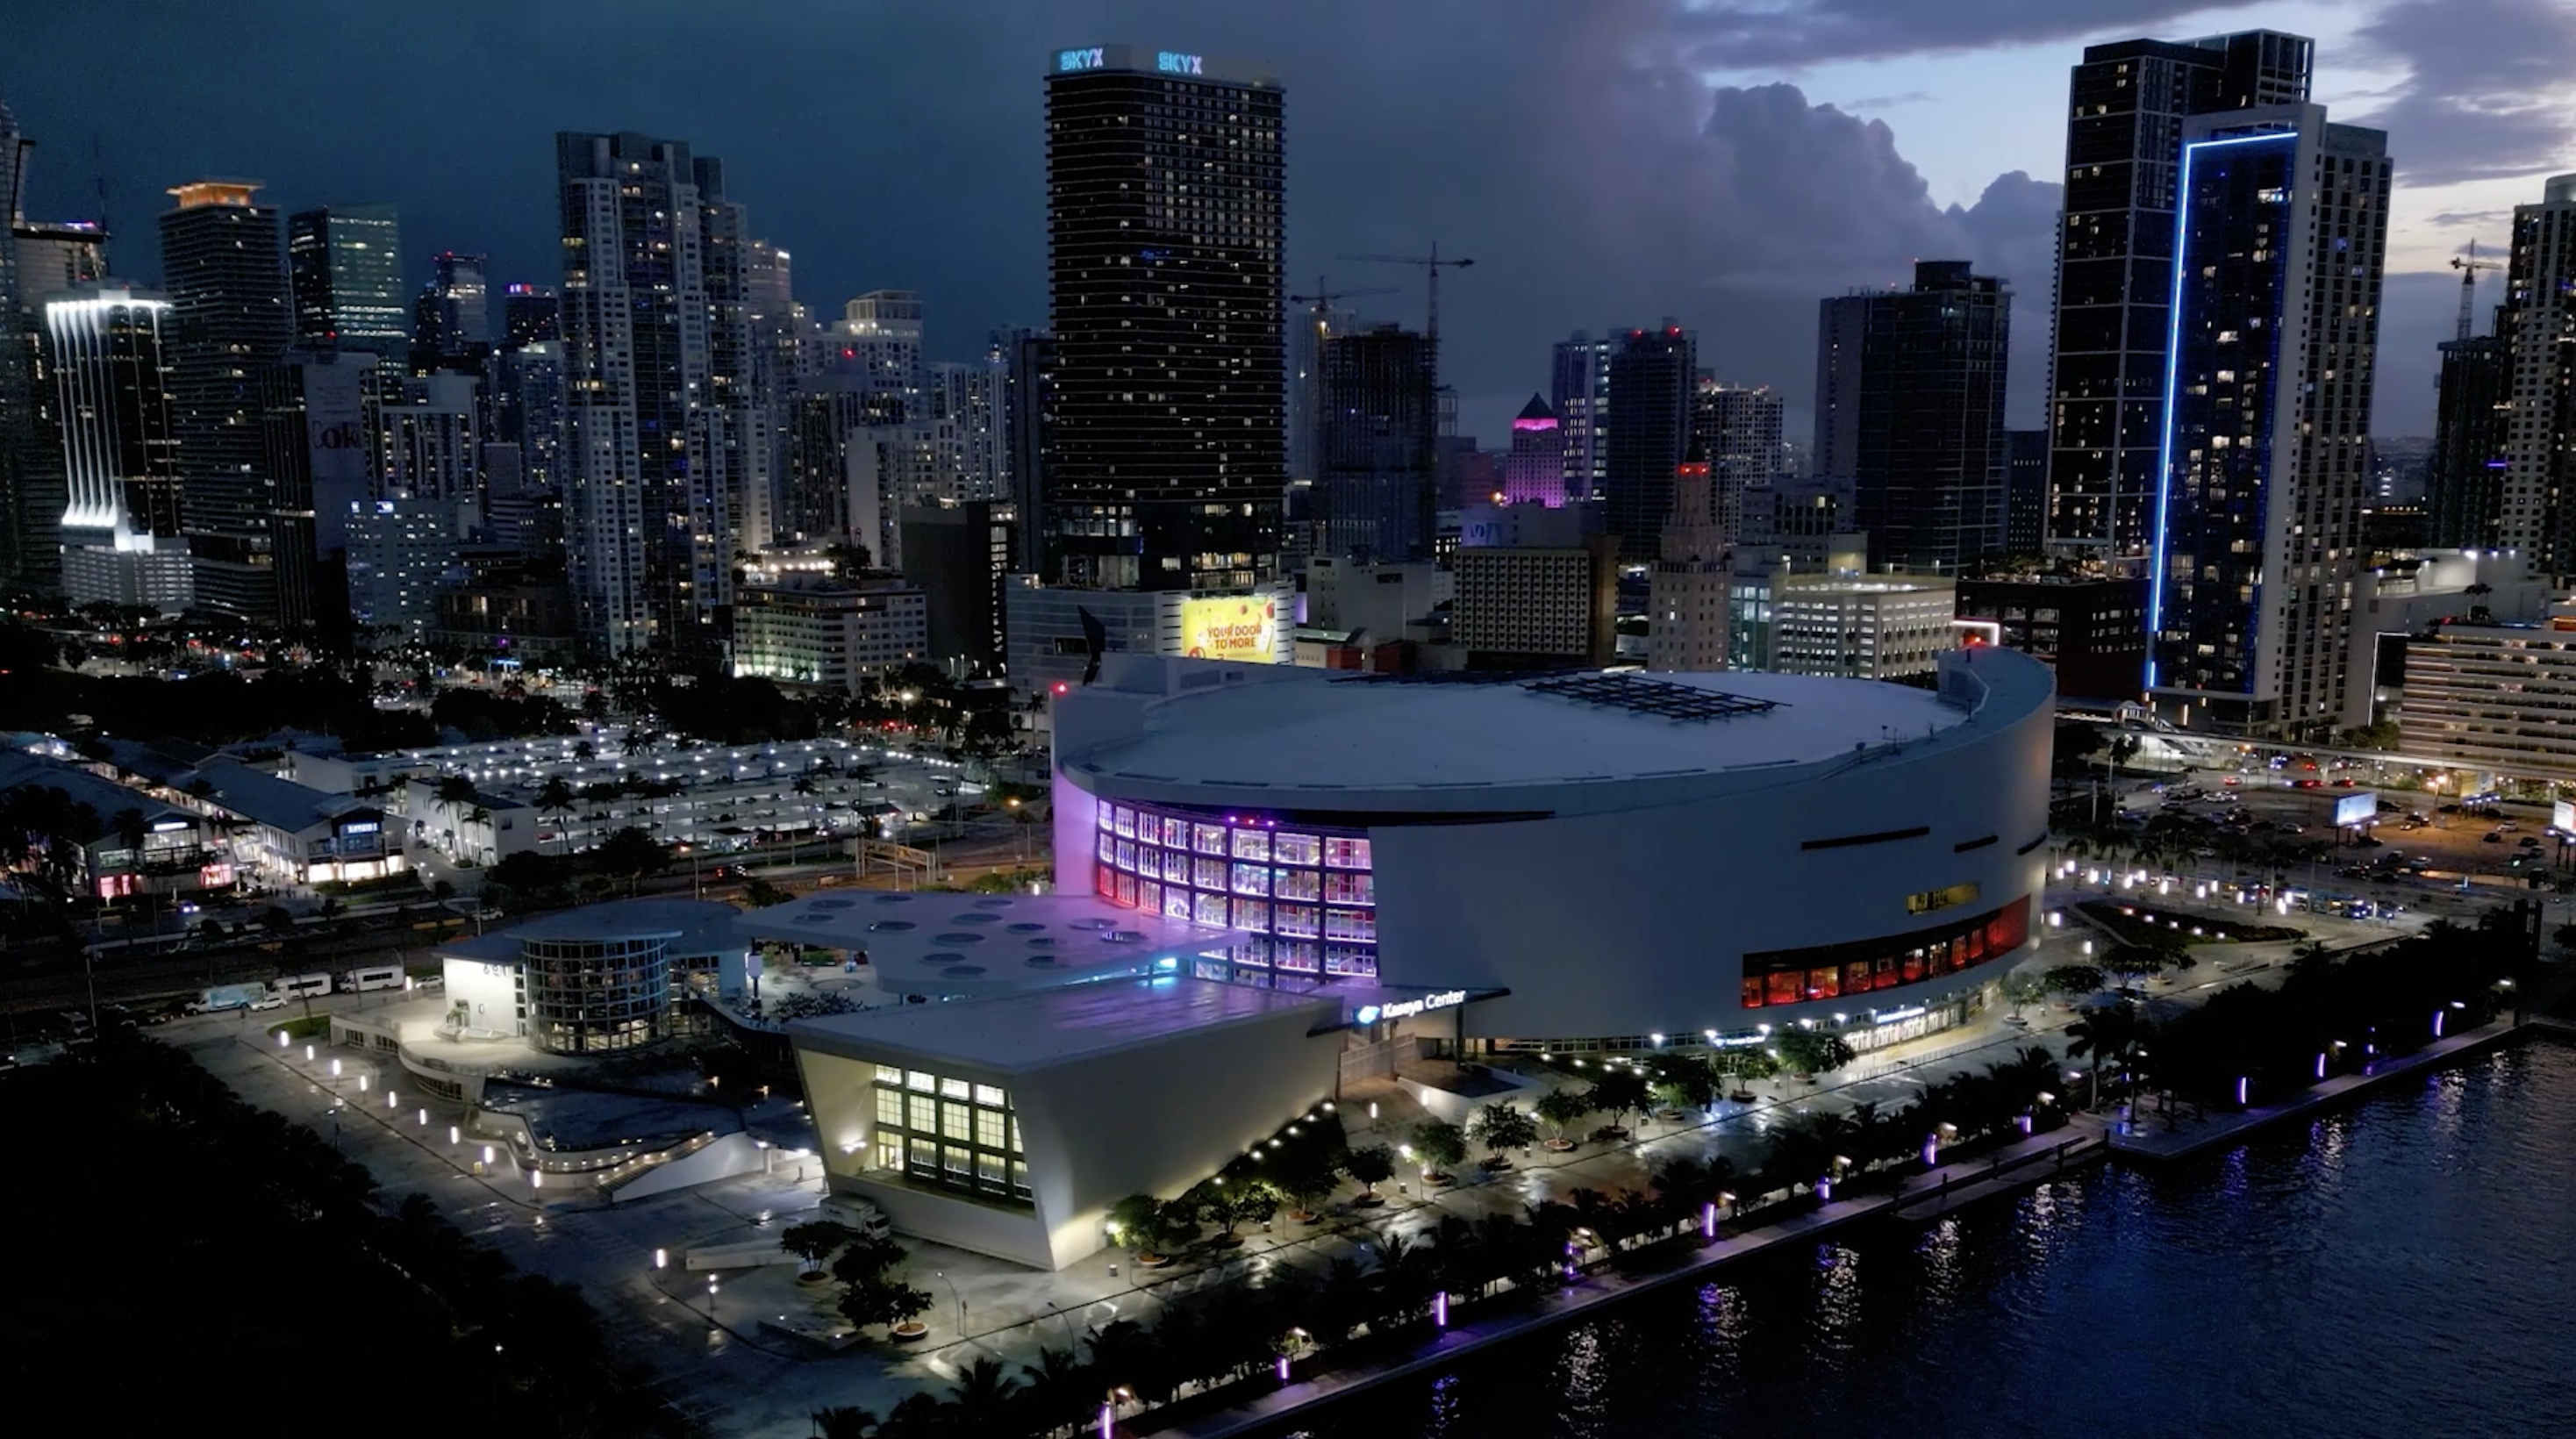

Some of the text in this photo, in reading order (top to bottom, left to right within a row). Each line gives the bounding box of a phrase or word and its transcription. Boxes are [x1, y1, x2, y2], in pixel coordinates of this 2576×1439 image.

[1060, 47, 1104, 71] SKYX
[1158, 51, 1202, 75] SKYX
[1207, 625, 1262, 638] YOUR DOOR
[1215, 637, 1256, 649] TO MORE
[1382, 990, 1466, 1019] Kaseya Center
